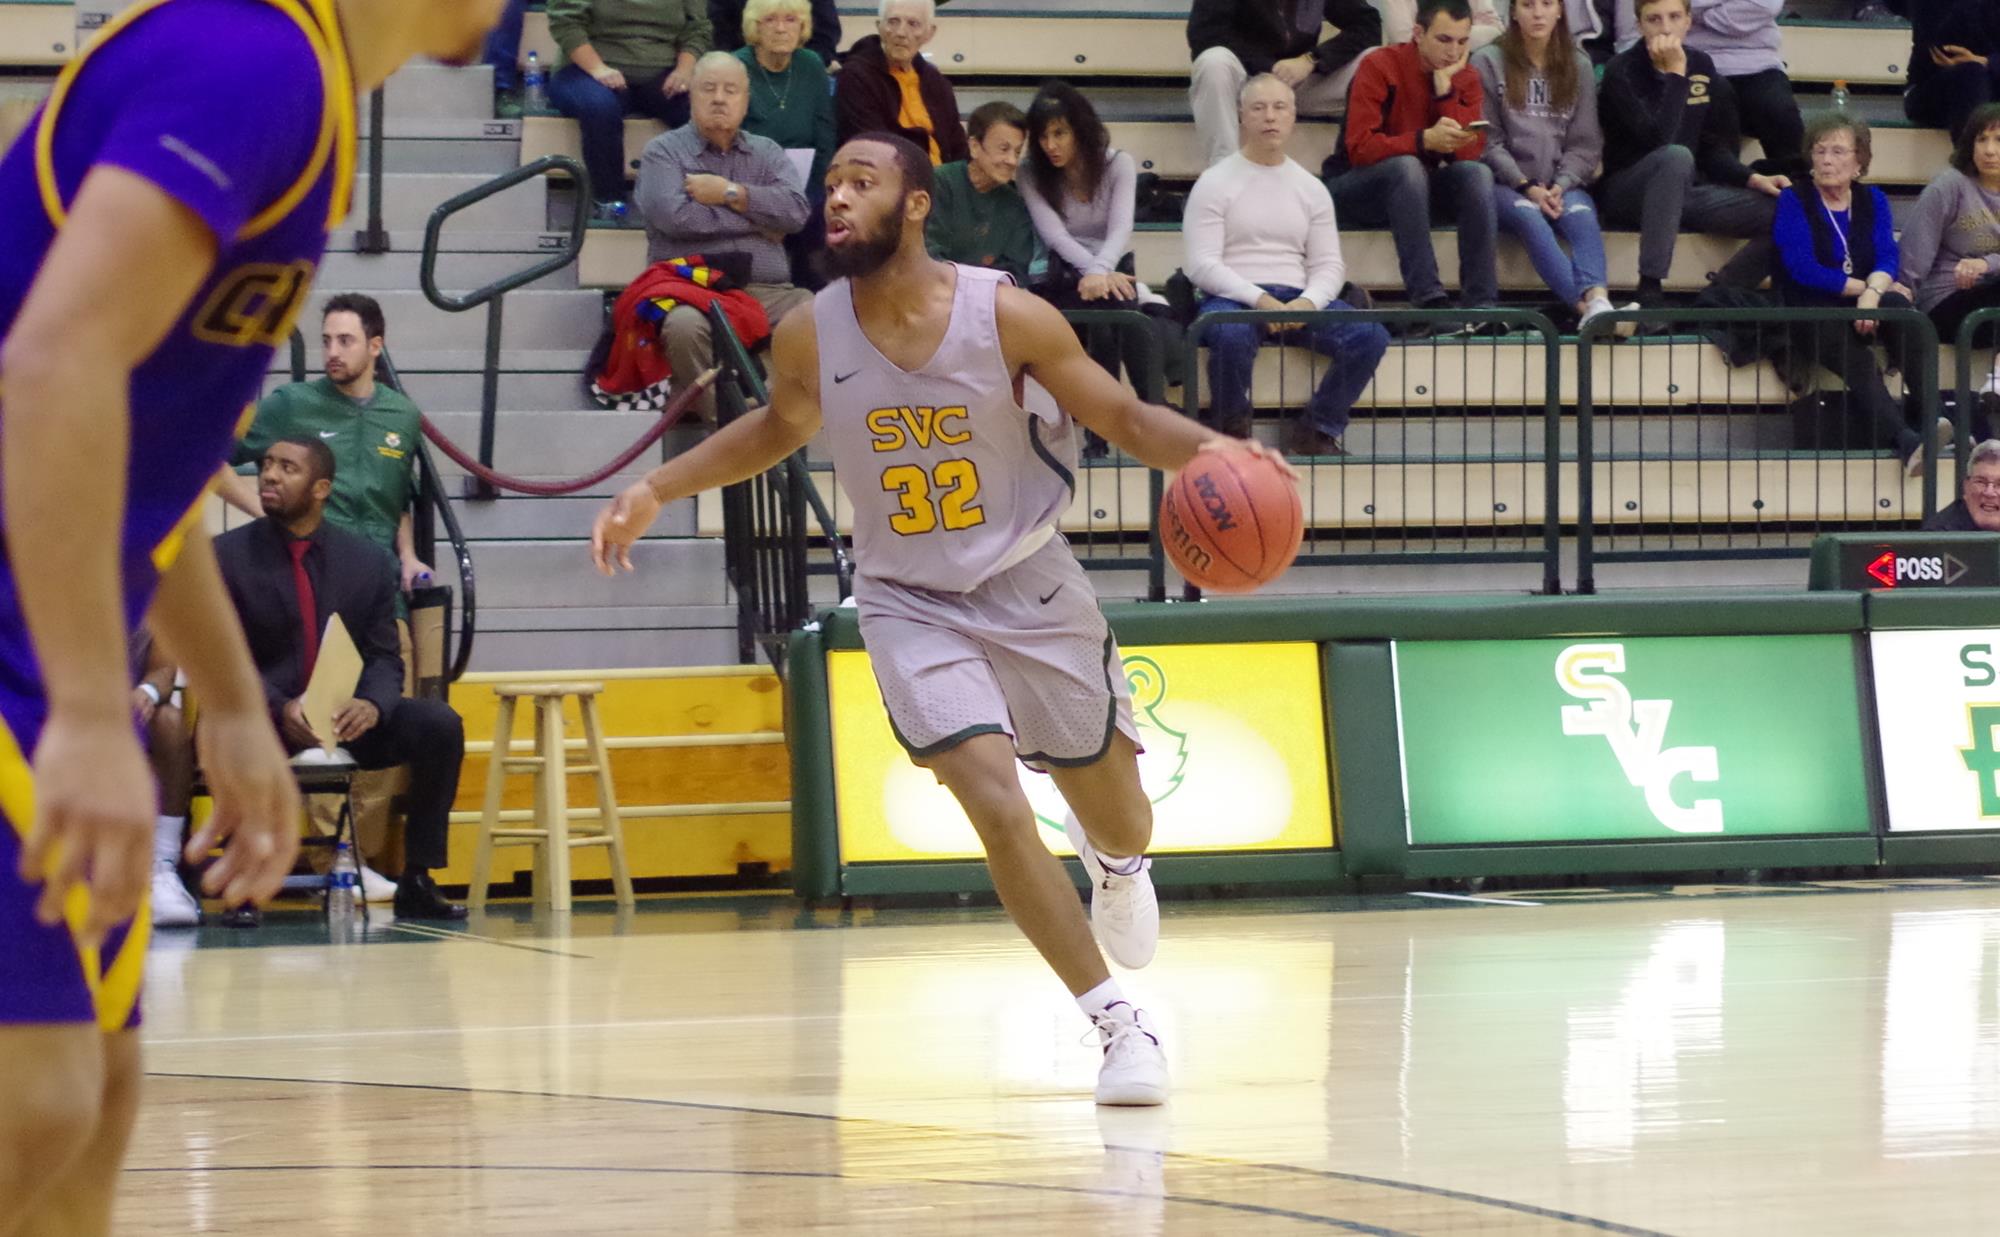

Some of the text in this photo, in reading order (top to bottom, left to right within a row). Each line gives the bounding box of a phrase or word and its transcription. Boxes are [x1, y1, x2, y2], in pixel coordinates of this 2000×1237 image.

[866, 405, 972, 452] SVC
[881, 457, 986, 536] 32
[1895, 556, 1944, 581] POSS
[1555, 643, 1724, 833] SVC
